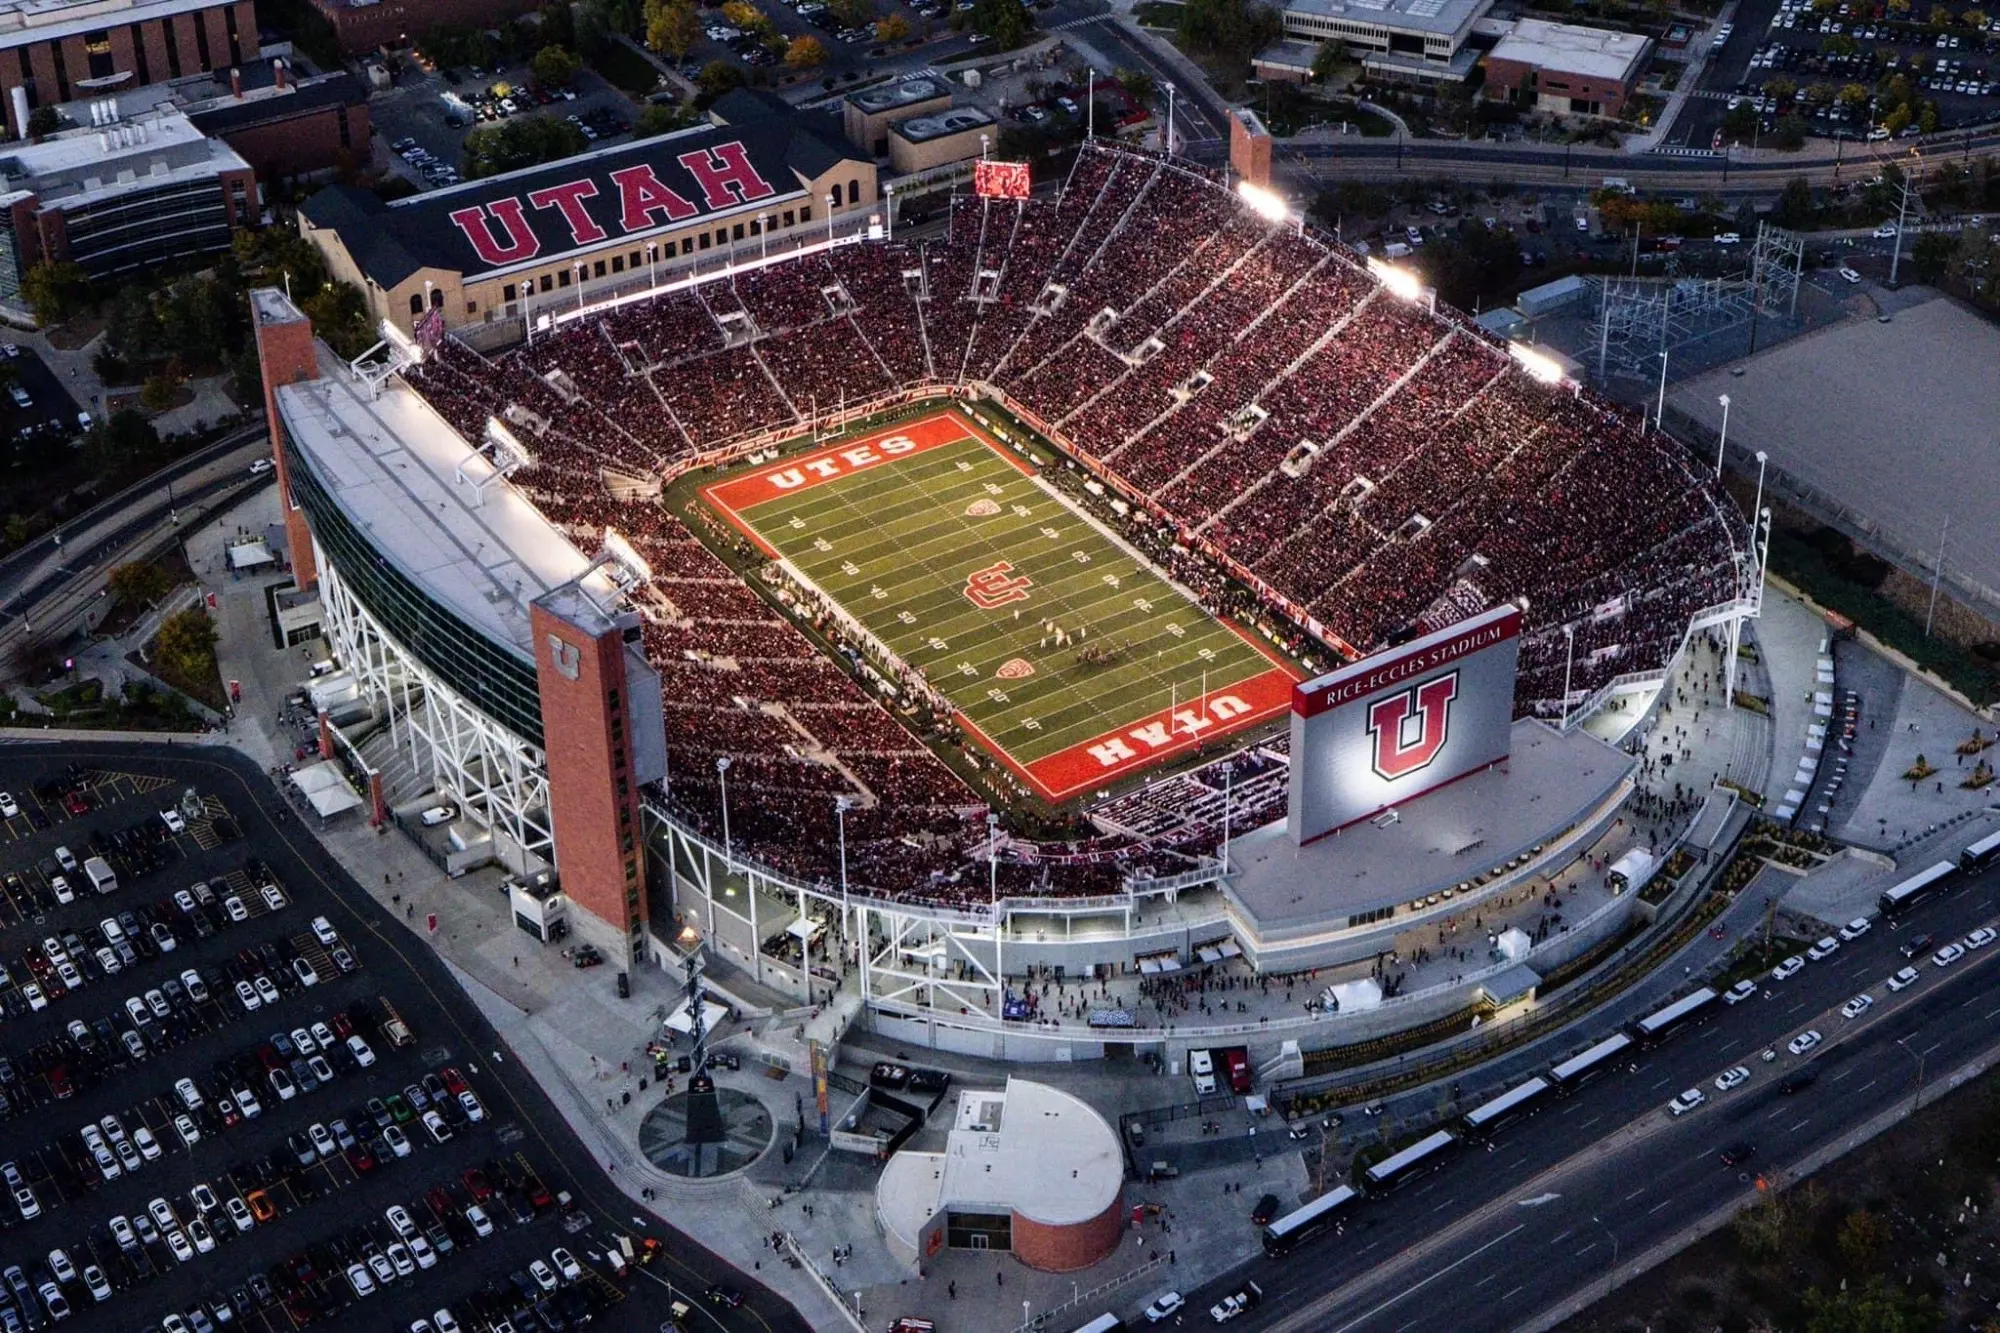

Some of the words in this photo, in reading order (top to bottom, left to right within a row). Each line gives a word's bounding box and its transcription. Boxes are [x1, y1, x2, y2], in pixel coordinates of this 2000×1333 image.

[449, 140, 776, 266] UTAH
[767, 436, 916, 489] UTES
[897, 611, 917, 624] 50
[547, 633, 581, 681] U
[1327, 656, 1425, 706] RICE-ECCLES
[1431, 626, 1501, 665] STADIUM
[1086, 695, 1253, 767] UTAH
[1366, 668, 1460, 782] U
